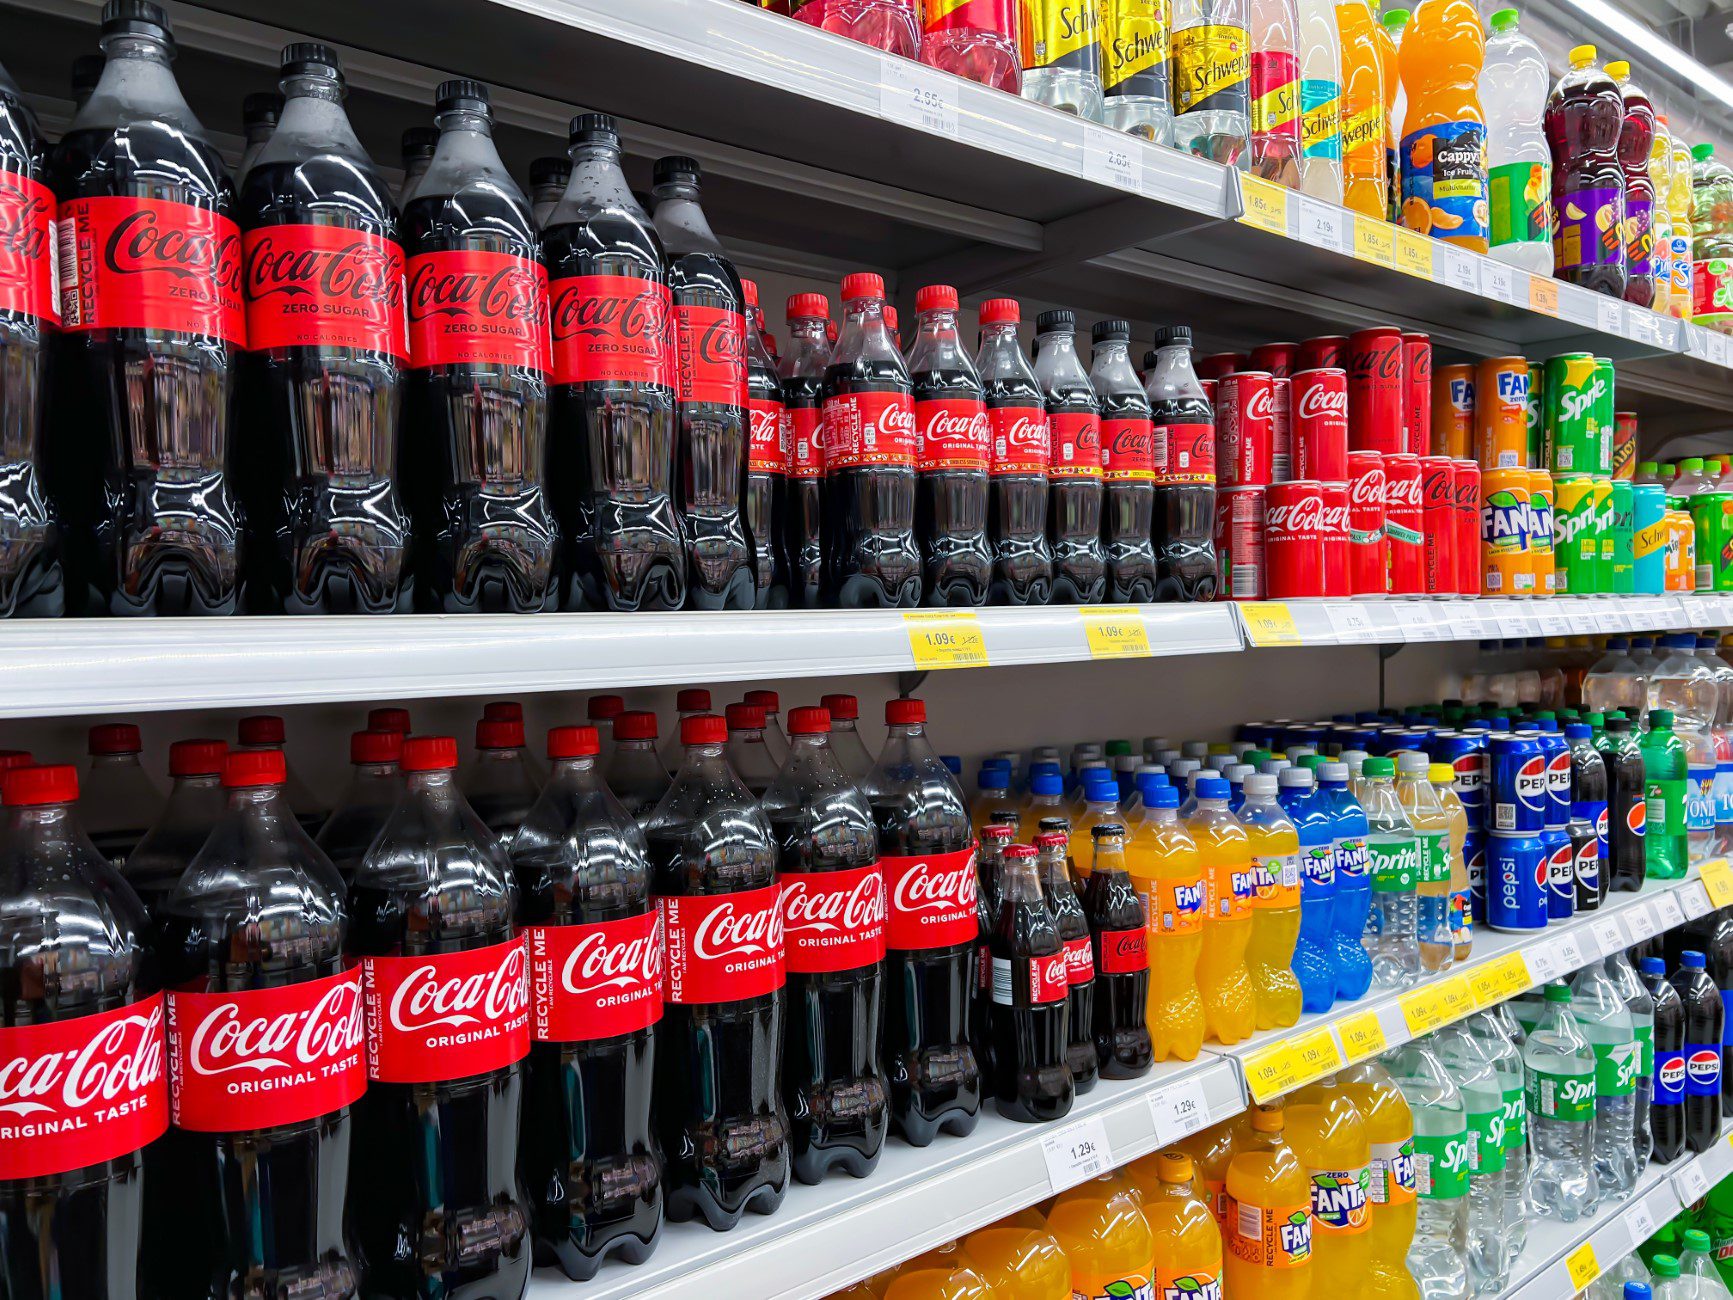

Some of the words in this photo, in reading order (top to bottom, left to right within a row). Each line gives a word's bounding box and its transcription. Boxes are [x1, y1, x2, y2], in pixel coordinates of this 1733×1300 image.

[1113, 27, 1171, 70] Schwep
[1195, 55, 1249, 92] Schwepp
[1302, 113, 1340, 139] Schwe
[1342, 116, 1380, 146] weppe
[1438, 151, 1480, 163] Cappy
[77, 202, 89, 233] ME
[104, 210, 240, 293] Coca-Co
[80, 239, 95, 324] RECYCLE
[245, 237, 402, 308] Coca-Cola
[169, 286, 208, 300] ZERO
[408, 262, 547, 327] Coca-Cola
[283, 303, 319, 314] ZERO
[322, 304, 371, 318] SUGAR
[678, 309, 689, 334] ME
[297, 334, 309, 342] NO
[311, 334, 358, 343] CALORIES
[444, 324, 478, 334] ZERO
[481, 324, 522, 337] SUGAR
[472, 352, 513, 360] CALORIES
[588, 344, 619, 353] ZERO
[622, 345, 657, 355] SUGAR
[614, 370, 649, 378] CALORIES
[680, 335, 693, 398] RECYCLE
[1498, 372, 1529, 396] FAN
[850, 397, 857, 412] ME
[851, 412, 860, 454] RECYCLE
[1413, 421, 1421, 455] ECYCLE
[1265, 496, 1324, 532] ca-Col
[1481, 500, 1530, 540] FAN
[1554, 497, 1595, 545] Spri
[1429, 533, 1435, 546] ME
[1428, 547, 1436, 591] RECYCLE
[925, 632, 956, 646] 1.09€
[1098, 626, 1124, 637] 1.09€
[1452, 774, 1483, 786] PEP
[1520, 778, 1545, 790] PEP
[1548, 773, 1571, 785] PEP
[1422, 837, 1428, 848] ME
[1303, 854, 1335, 877] FANT
[1336, 844, 1369, 868] FANT
[1368, 847, 1416, 875] Sprite
[1579, 861, 1598, 871] PEP
[894, 854, 976, 912] Coca-Co
[1208, 867, 1215, 880] ME
[1250, 866, 1274, 886] NTA
[1499, 857, 1520, 909] pepsi
[1551, 866, 1572, 877] PEP
[1151, 880, 1158, 896] ME
[1175, 880, 1201, 906] FAN
[668, 898, 680, 924] ME
[920, 911, 968, 925] ORIGINAL
[1151, 898, 1159, 933] RECYCLE
[533, 928, 546, 956] ME
[798, 933, 856, 947] ORIGINAL
[859, 926, 883, 941] TASTE
[363, 958, 375, 989] ME
[668, 928, 683, 1003] RECYCLE
[724, 956, 777, 974] ORIGINAL
[1032, 959, 1038, 969] ME
[389, 946, 529, 1032] Coca-Col
[534, 961, 549, 1040] RECYCLE
[596, 987, 653, 1008] ORIGINAL
[166, 993, 177, 1027] ME
[190, 974, 365, 1075] Coca-Cola
[366, 993, 380, 1080] RECYCLE
[425, 1026, 501, 1049] ORIGINAL
[503, 1011, 529, 1033] TASTE
[1350, 1031, 1367, 1044] 1.09€
[0, 1005, 163, 1108] ca-Cola
[1302, 1049, 1320, 1063] 1.09€
[1689, 1062, 1719, 1071] PEPSI
[168, 1032, 181, 1126] RECYCLE
[226, 1070, 316, 1095] ORIGINAL
[320, 1053, 359, 1078] TASTE
[1257, 1066, 1278, 1081] 1.09€
[1560, 1074, 1596, 1105] Spri
[0, 1115, 88, 1140] RIGINAL
[94, 1094, 149, 1124] TASTE
[1174, 1099, 1196, 1115] 1.29€
[1071, 1141, 1096, 1160] 1.29€
[1326, 1171, 1349, 1179] ZERO
[1266, 1209, 1273, 1220] ME
[1282, 1218, 1312, 1251] FAN
